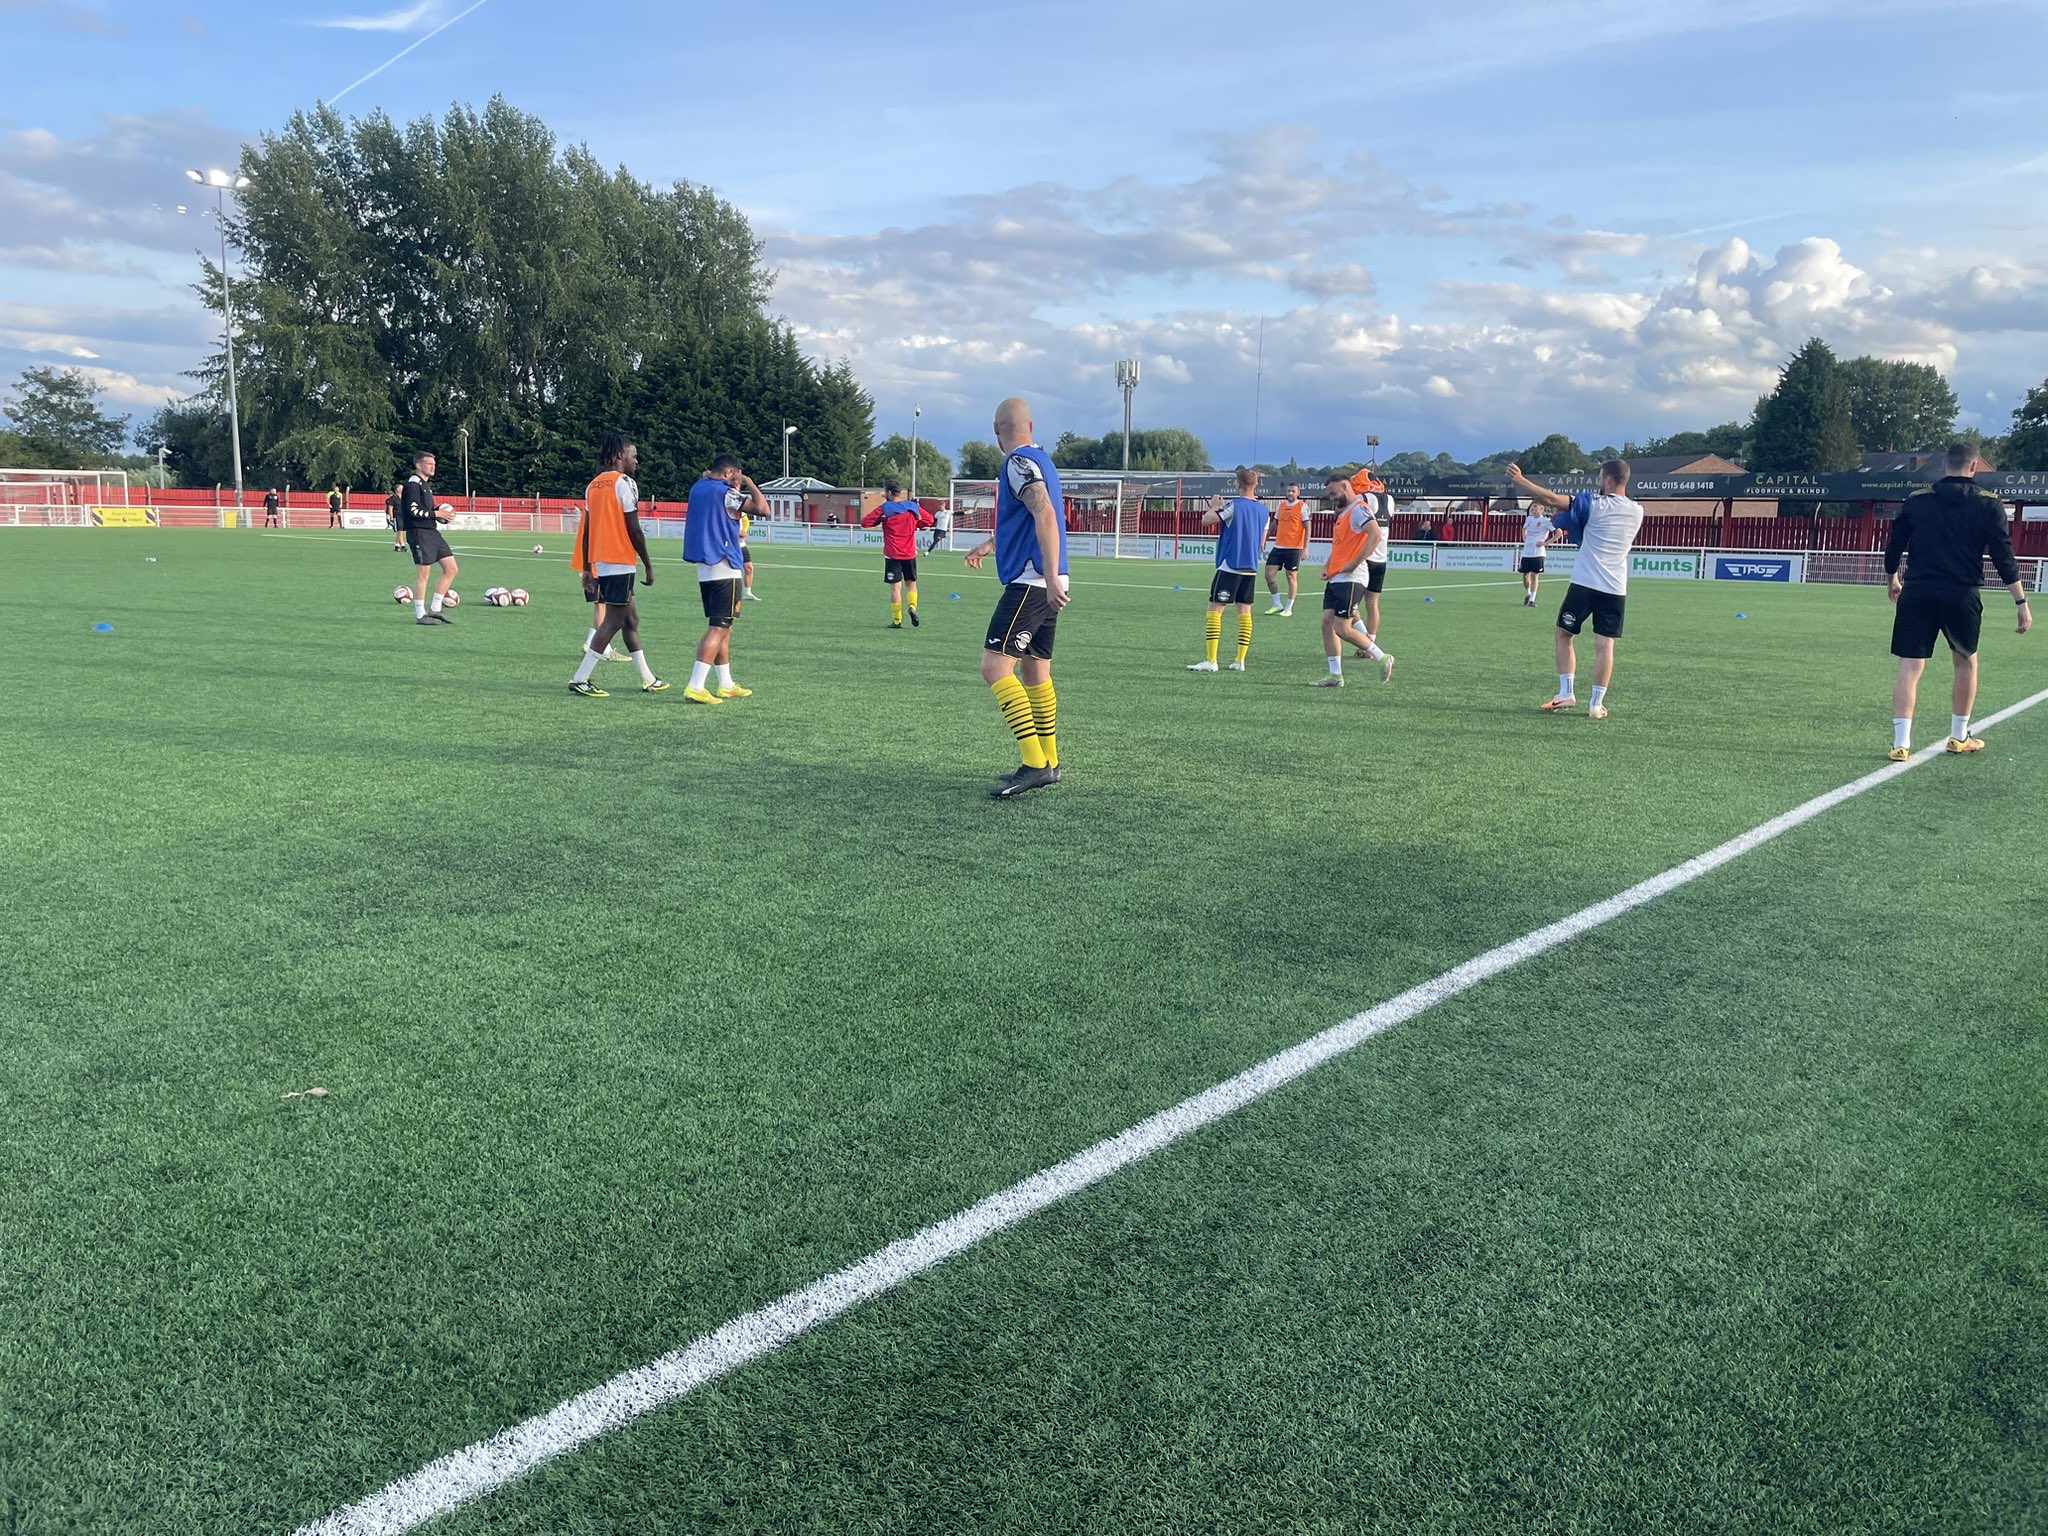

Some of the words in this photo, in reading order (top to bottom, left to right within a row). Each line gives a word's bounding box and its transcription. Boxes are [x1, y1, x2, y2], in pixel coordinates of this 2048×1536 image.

[1382, 478, 1418, 486] APITAL
[1548, 476, 1601, 486] CAPITAL
[1755, 475, 1818, 485] CAPITAL
[2005, 474, 2046, 485] CAPI
[1637, 481, 1660, 490] CALL:
[1661, 481, 1678, 490] 0115
[1679, 481, 1696, 490] 648
[1696, 481, 1715, 490] 1418
[748, 529, 767, 538] unts
[864, 534, 882, 543] Hun
[1632, 557, 1693, 572] Hunts
